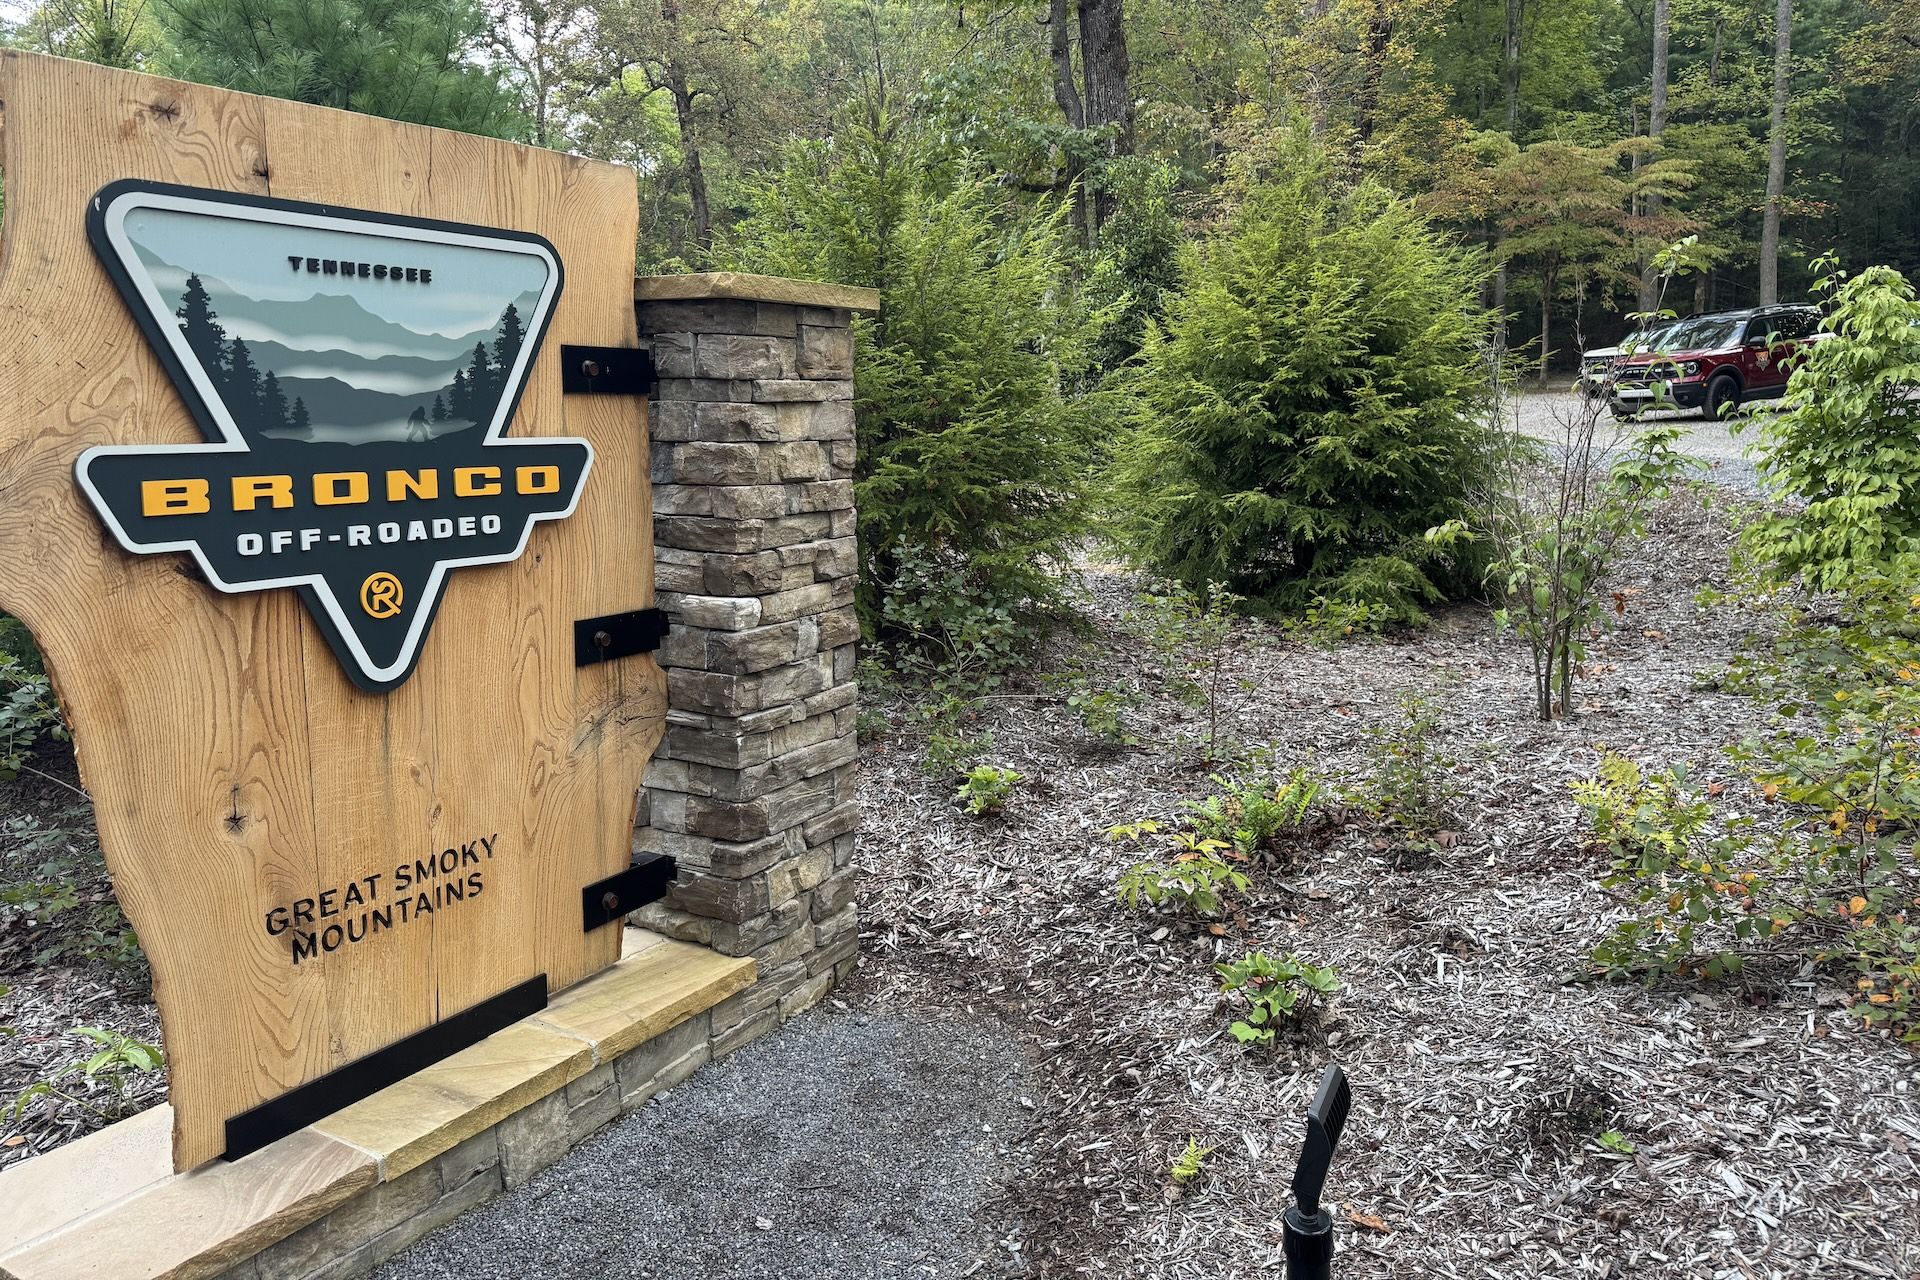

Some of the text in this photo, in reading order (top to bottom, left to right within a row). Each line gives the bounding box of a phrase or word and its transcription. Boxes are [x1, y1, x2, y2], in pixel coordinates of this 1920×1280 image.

[288, 255, 432, 283] TENNESSEE
[141, 465, 560, 517] BRONCO
[236, 514, 501, 556] OFF-ROADEO
[266, 833, 498, 936] GREAT SMOKY
[292, 872, 483, 965] MOUNTAINS
